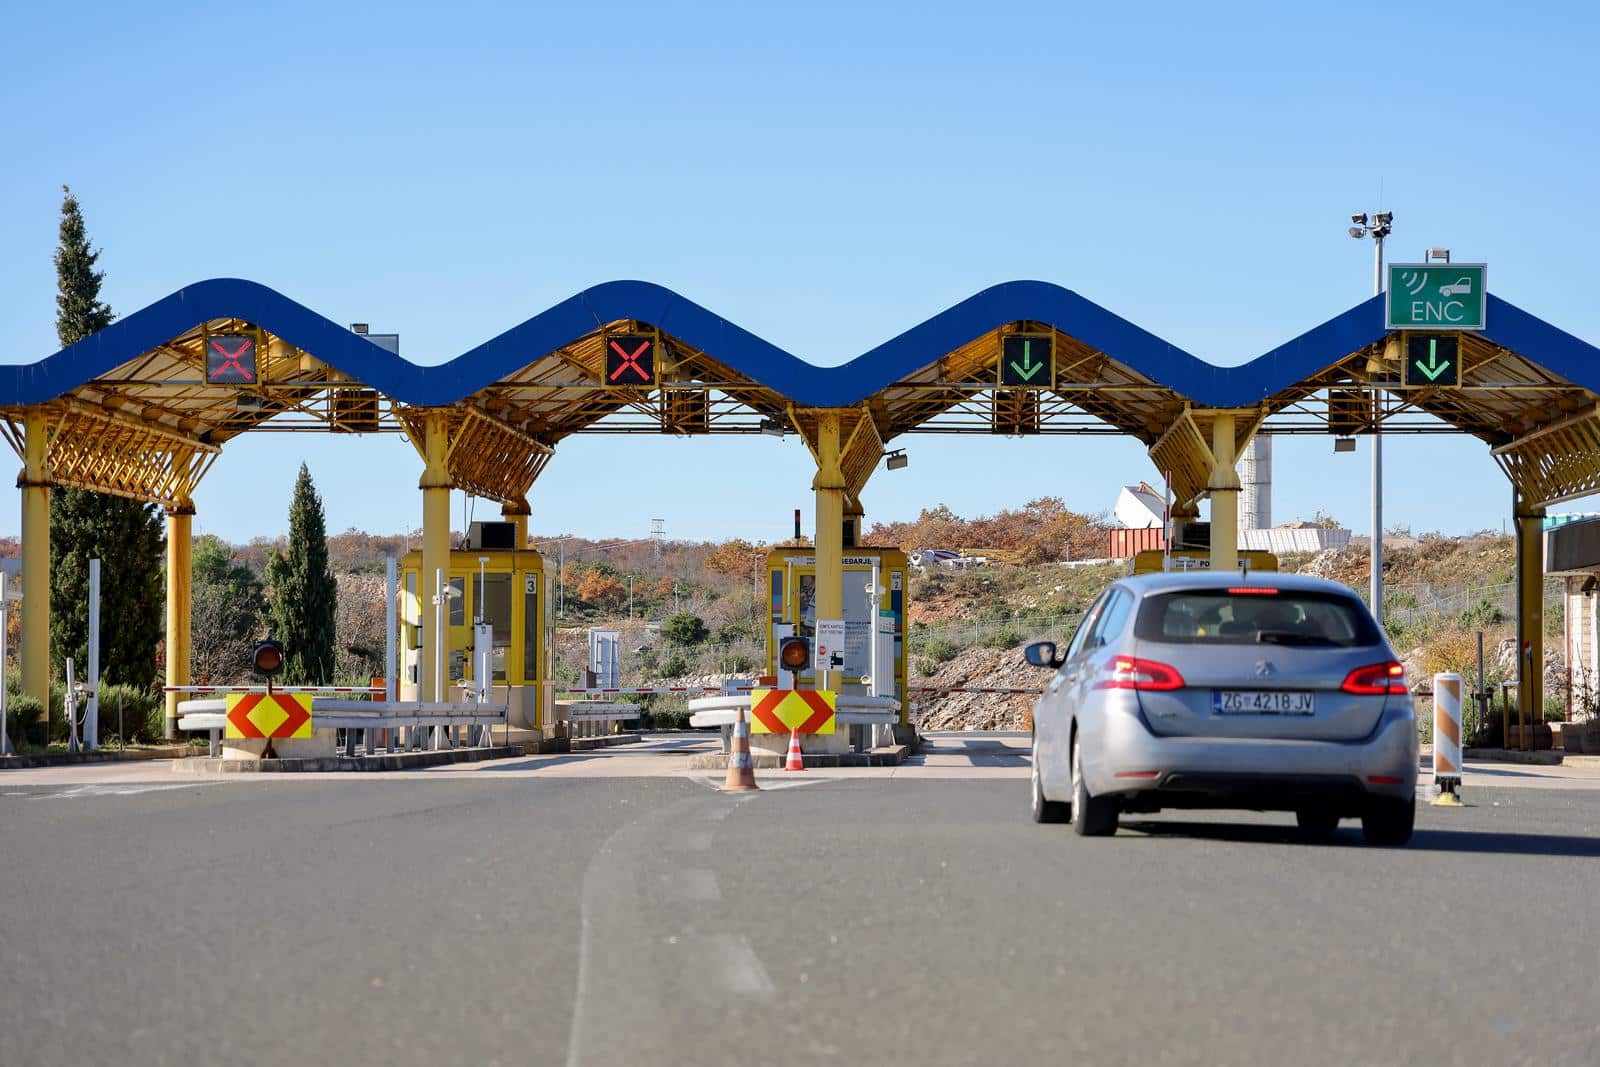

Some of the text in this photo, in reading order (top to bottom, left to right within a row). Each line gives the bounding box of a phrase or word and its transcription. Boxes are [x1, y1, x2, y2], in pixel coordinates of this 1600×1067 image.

[1411, 301, 1464, 321] ENC
[527, 580, 535, 592] 3
[1224, 692, 1242, 710] ZG
